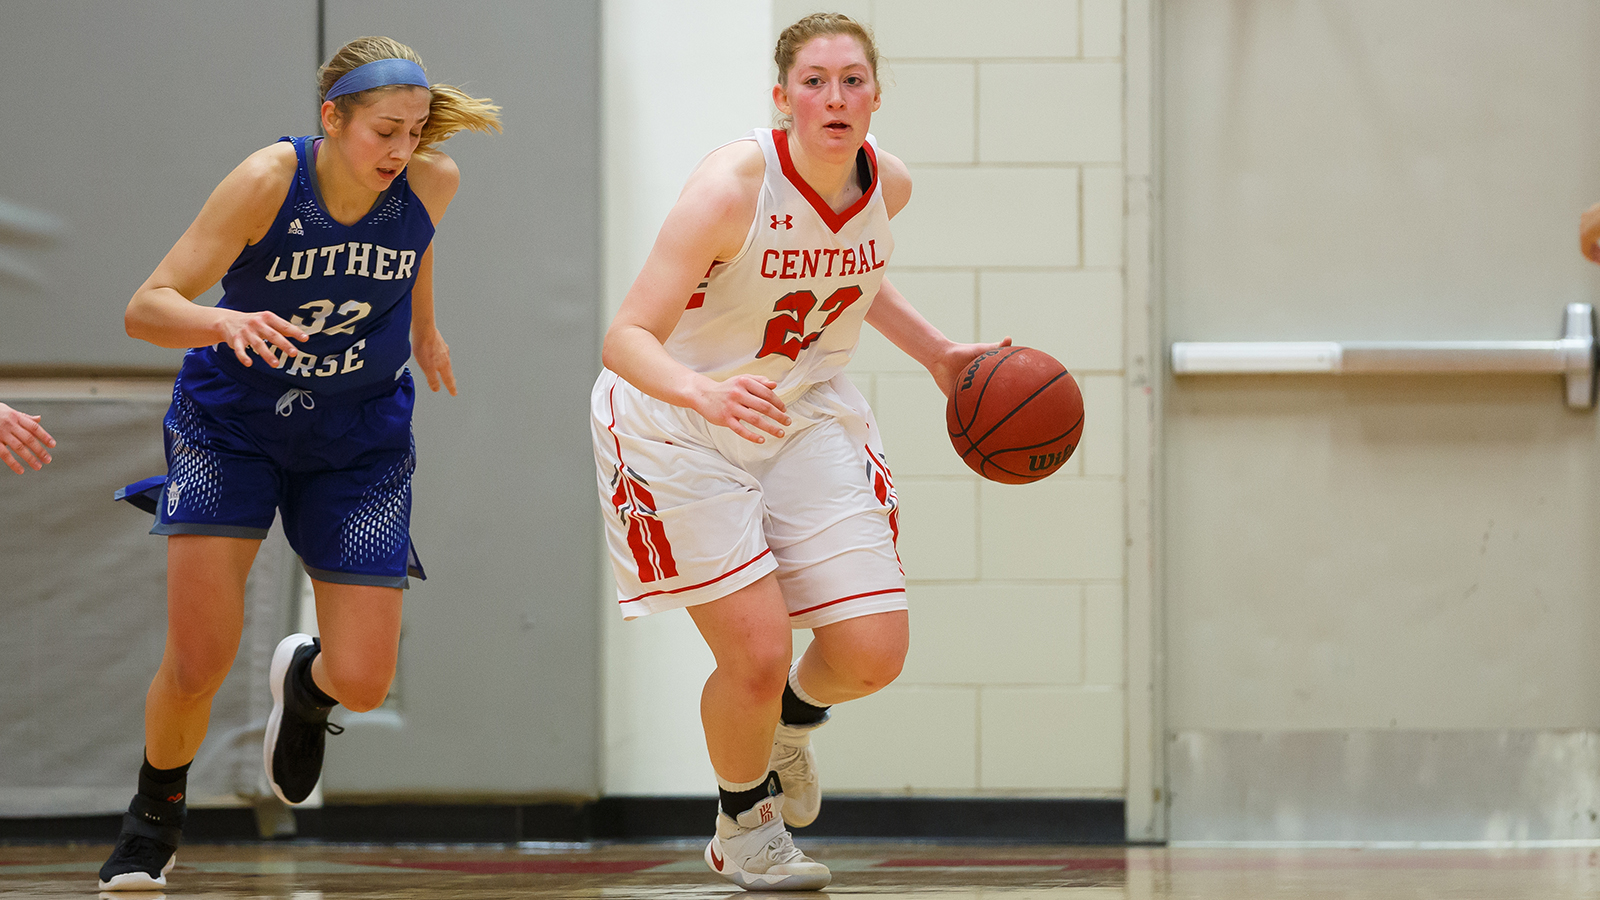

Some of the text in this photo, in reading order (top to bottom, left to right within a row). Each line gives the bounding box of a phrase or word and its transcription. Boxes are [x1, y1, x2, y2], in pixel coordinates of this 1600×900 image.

[265, 242, 417, 282] LUTHER
[761, 239, 885, 280] CENTRAL
[290, 299, 372, 337] 32
[247, 337, 367, 378] ORSE
